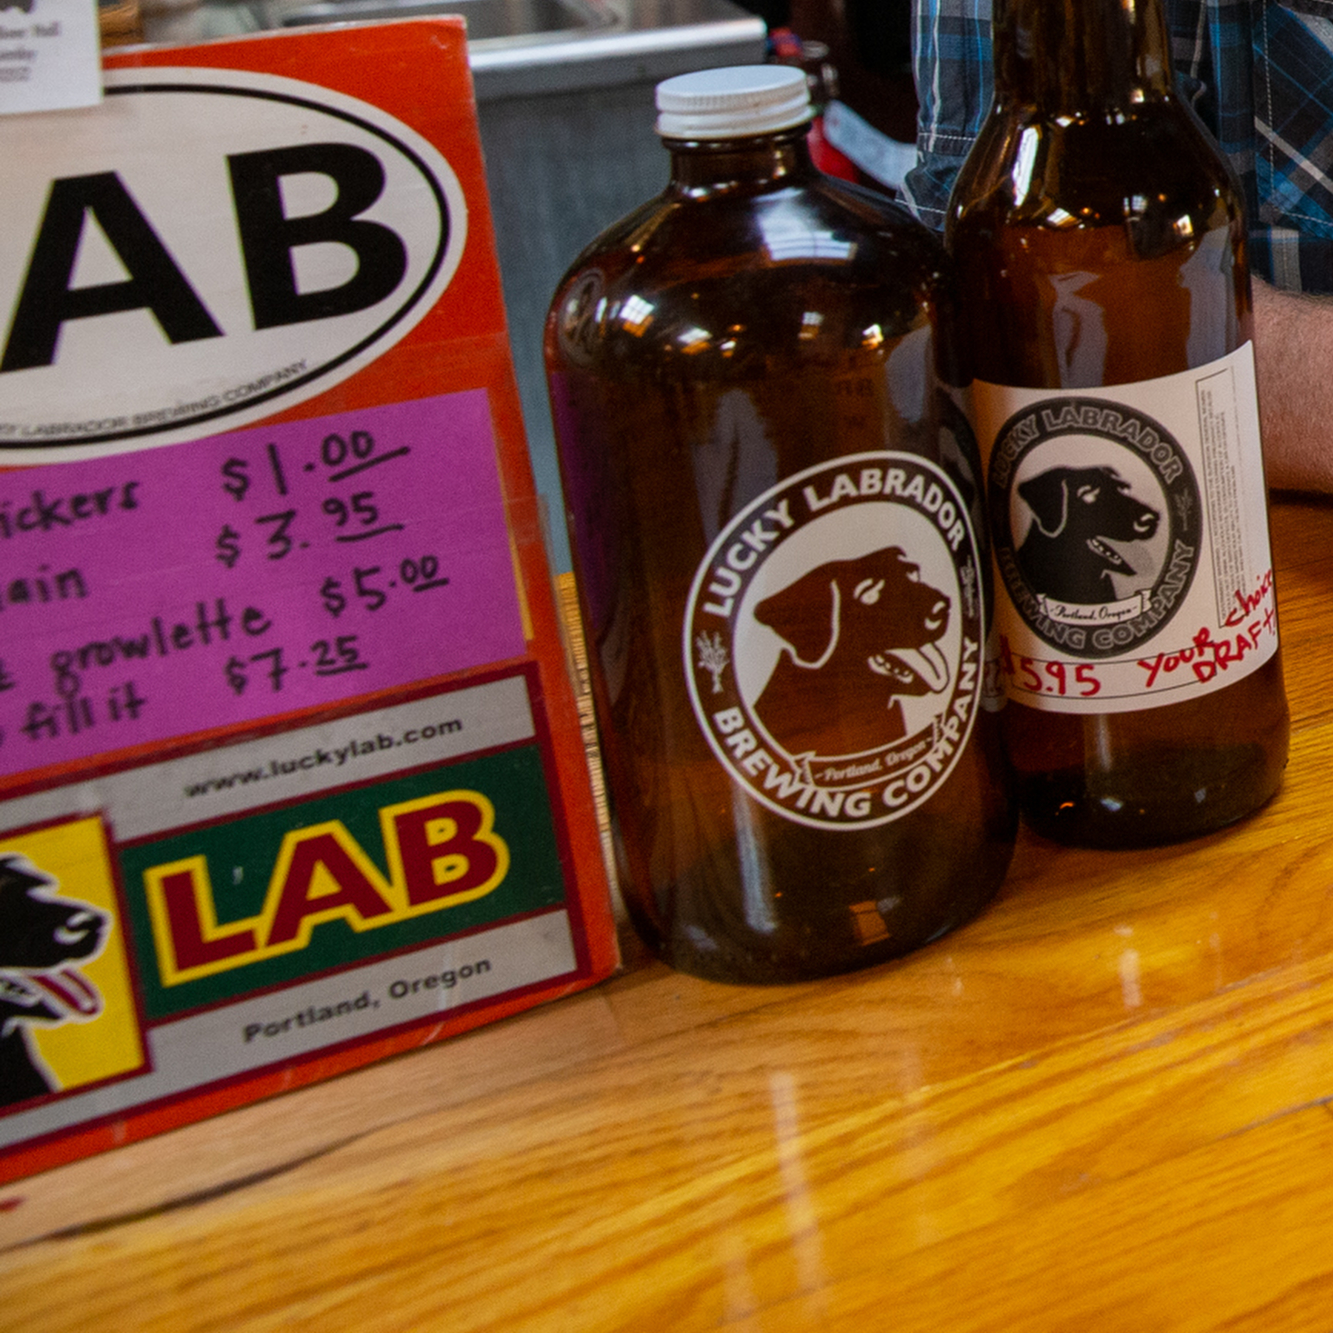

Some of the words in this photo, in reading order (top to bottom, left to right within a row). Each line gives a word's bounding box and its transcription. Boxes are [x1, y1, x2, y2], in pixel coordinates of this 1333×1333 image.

[221, 358, 308, 403] COMPANY
[220, 429, 378, 502] $1.00
[990, 413, 1041, 489] LUCKY
[1041, 405, 1184, 485] LABRADOR
[214, 490, 380, 568] $3.95
[703, 498, 796, 619] LUCKY
[803, 467, 966, 552] LABRADOR
[49, 597, 273, 701] growlette
[319, 553, 442, 619] $5.00
[1000, 545, 1088, 650] BREWING
[1092, 539, 1196, 651] COMPANY
[1097, 606, 1137, 623] Oregon
[21, 695, 96, 743] fill
[107, 679, 146, 723] it
[223, 632, 362, 697] $7.25
[1137, 625, 1212, 689] YOUR
[183, 714, 465, 799] www.luckylab.com
[712, 705, 873, 819] BREWING
[882, 635, 980, 809] COMPANY
[885, 739, 930, 768] Oregon
[142, 787, 512, 989] LAB
[242, 987, 381, 1044] Portland,
[388, 955, 493, 1001] Oregon
